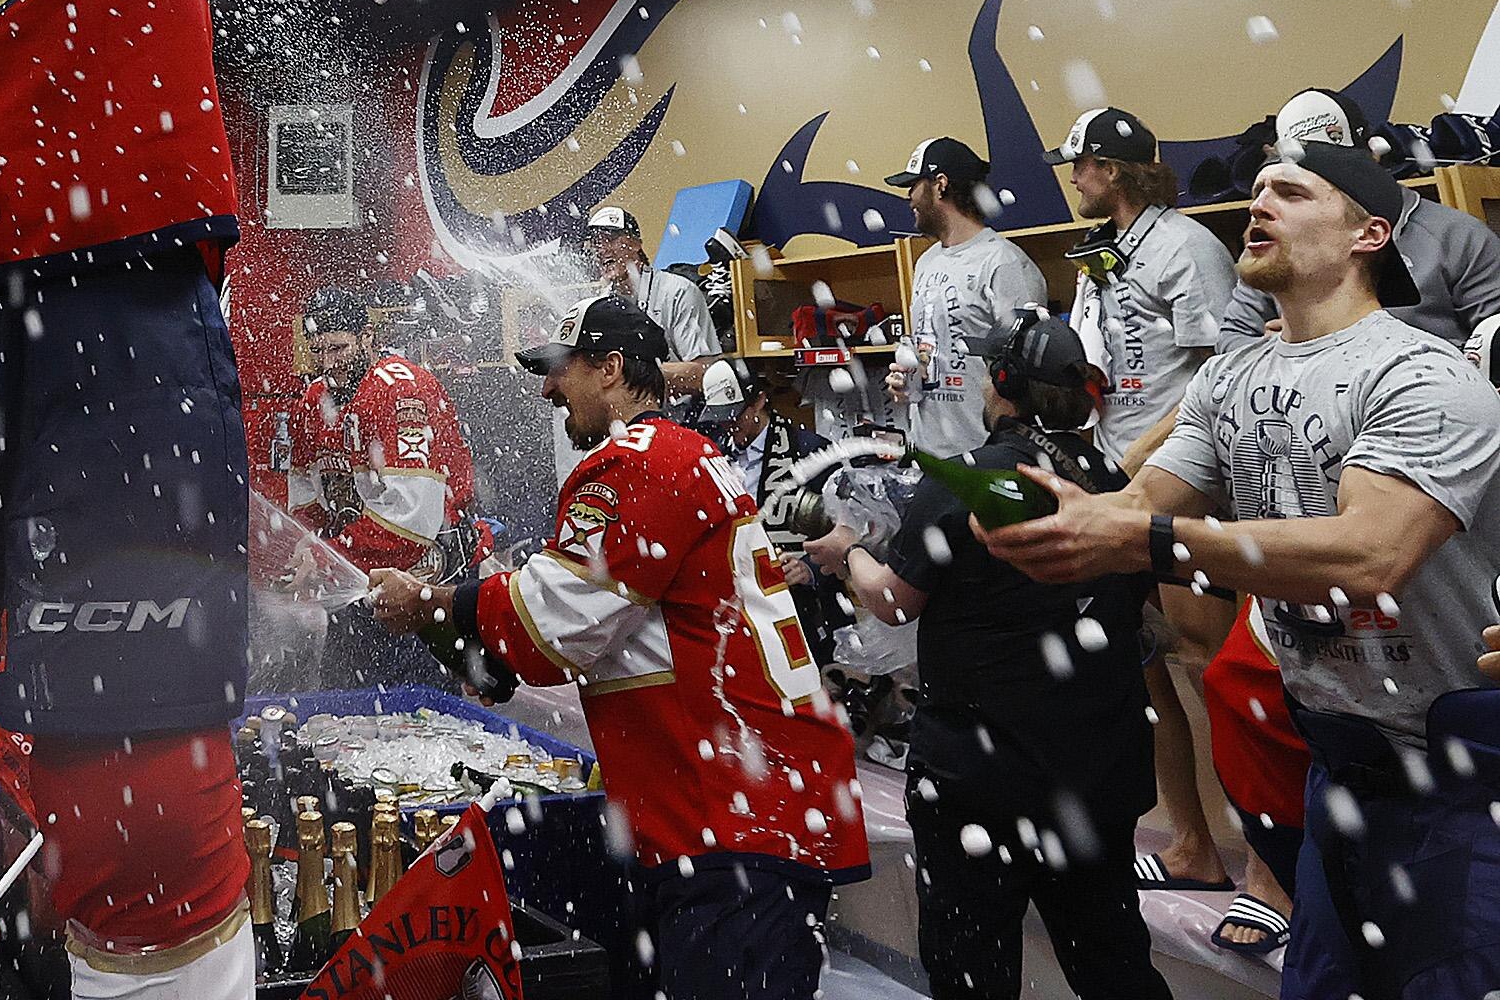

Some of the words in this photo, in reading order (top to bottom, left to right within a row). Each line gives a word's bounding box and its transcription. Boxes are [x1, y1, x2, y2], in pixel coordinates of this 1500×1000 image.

[1115, 285, 1146, 371] HAMPS
[373, 361, 417, 387] 19
[1120, 377, 1144, 389] 25
[1250, 384, 1305, 417] CUP
[27, 597, 191, 632] CCM
[305, 904, 480, 1000] STANLEY
